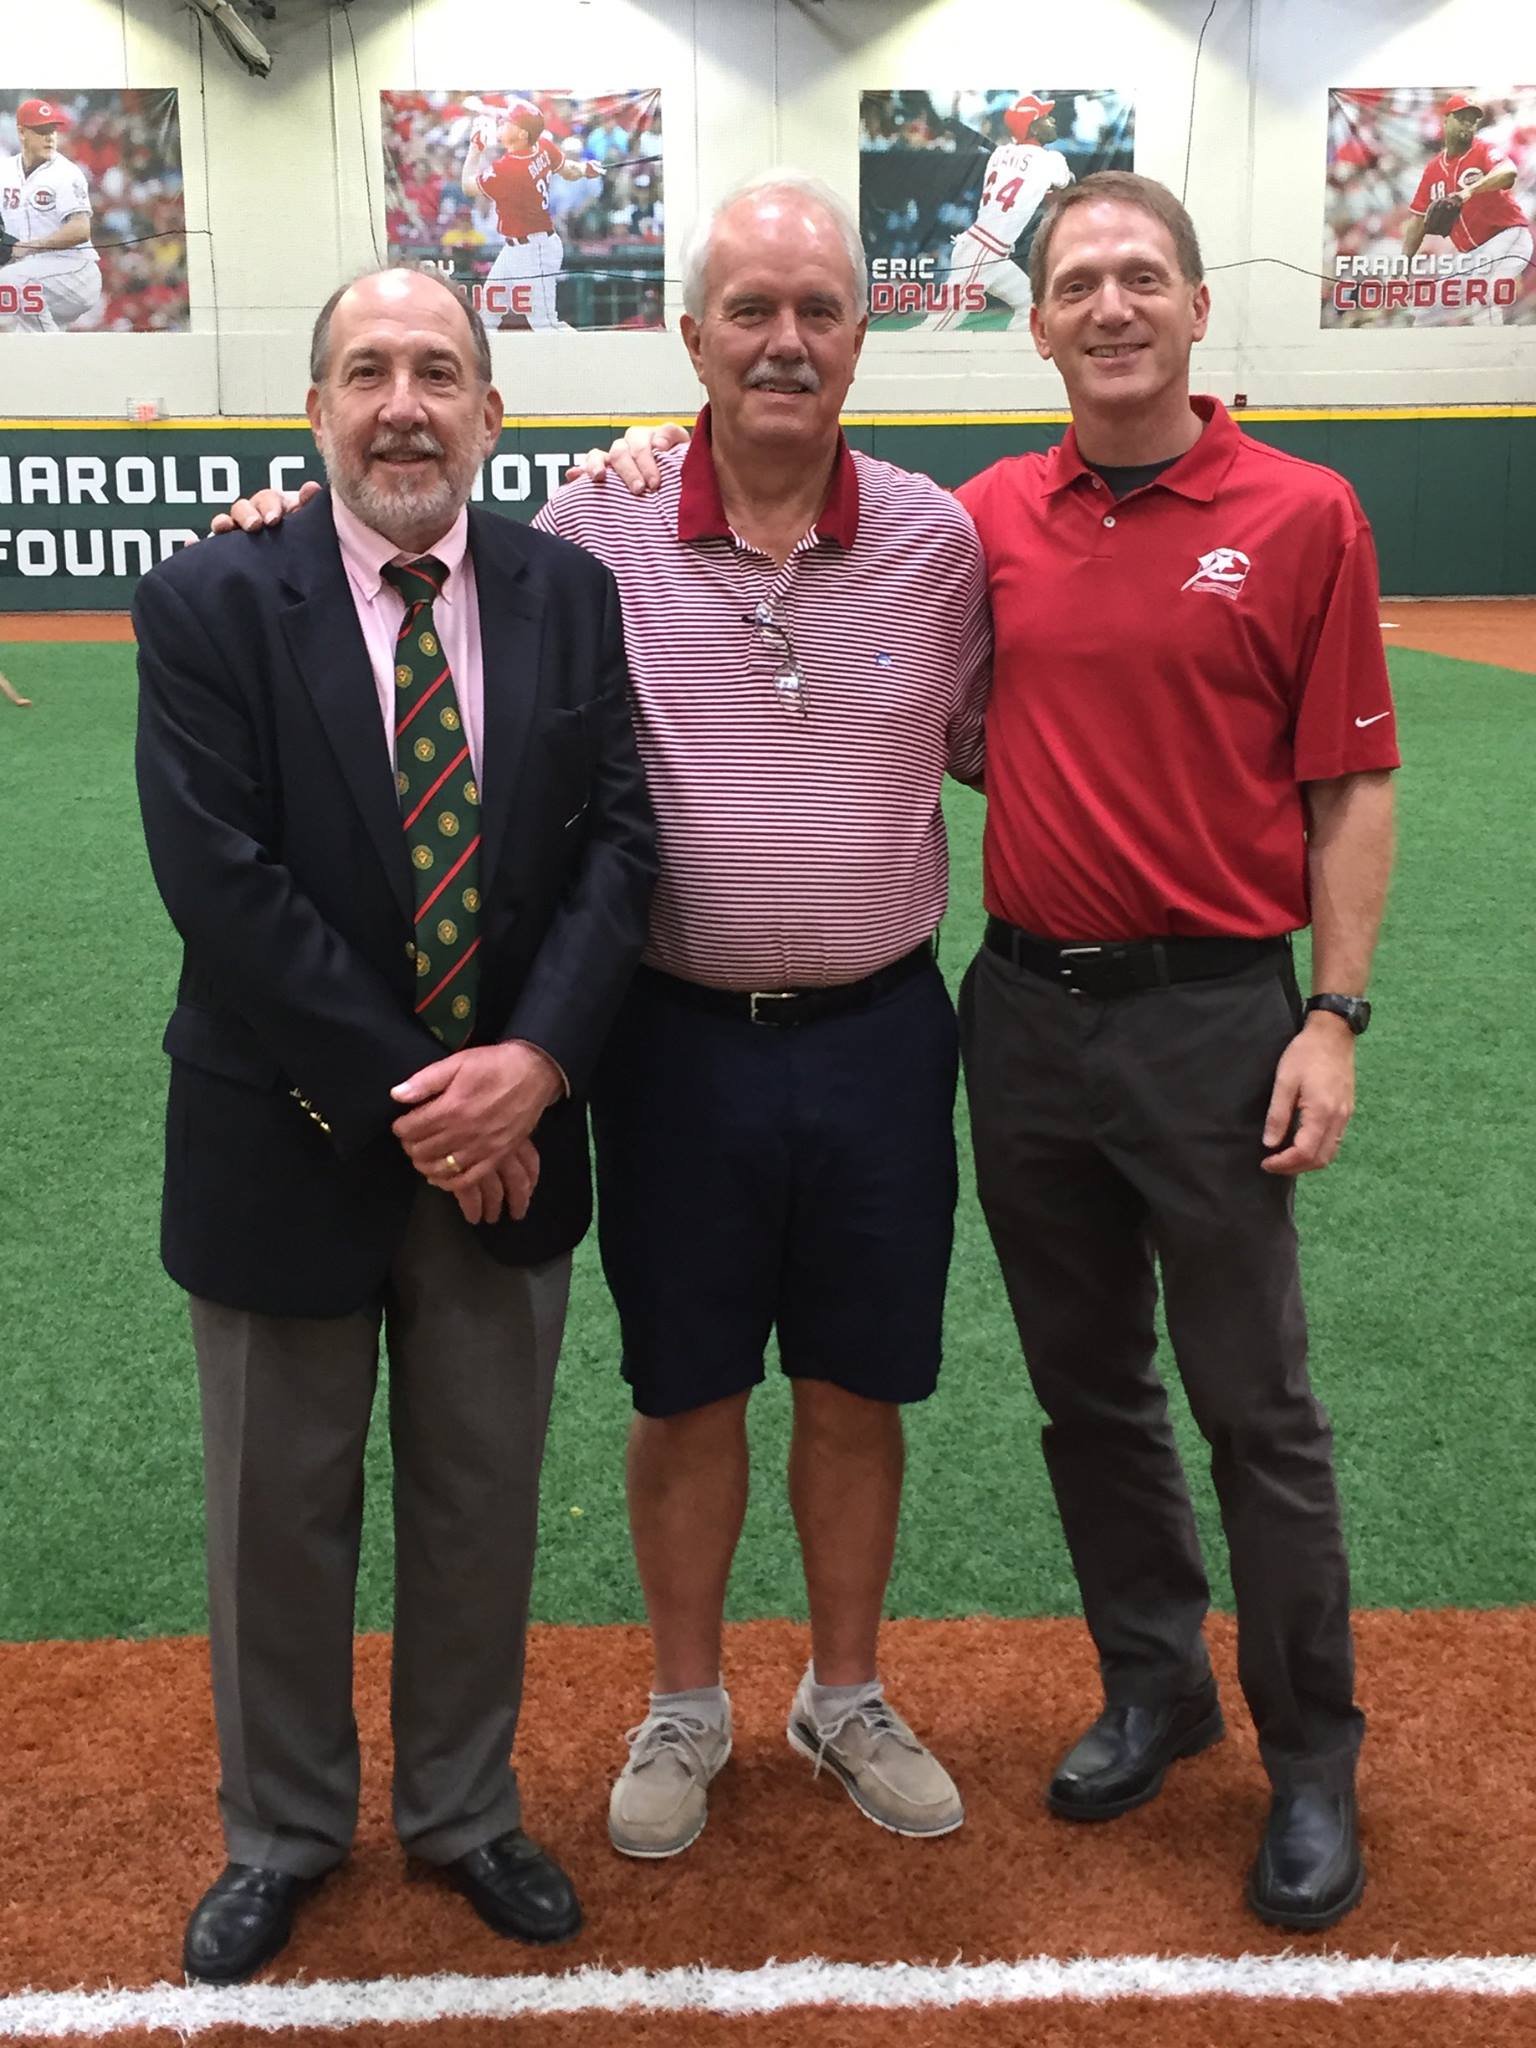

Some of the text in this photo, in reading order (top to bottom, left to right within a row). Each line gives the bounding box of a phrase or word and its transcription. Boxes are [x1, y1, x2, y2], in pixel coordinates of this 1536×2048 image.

[872, 258, 935, 279] ERIC
[1335, 253, 1491, 276] FRANCISCO
[871, 283, 987, 313] DAVIS
[1334, 278, 1516, 310] CORDERO
